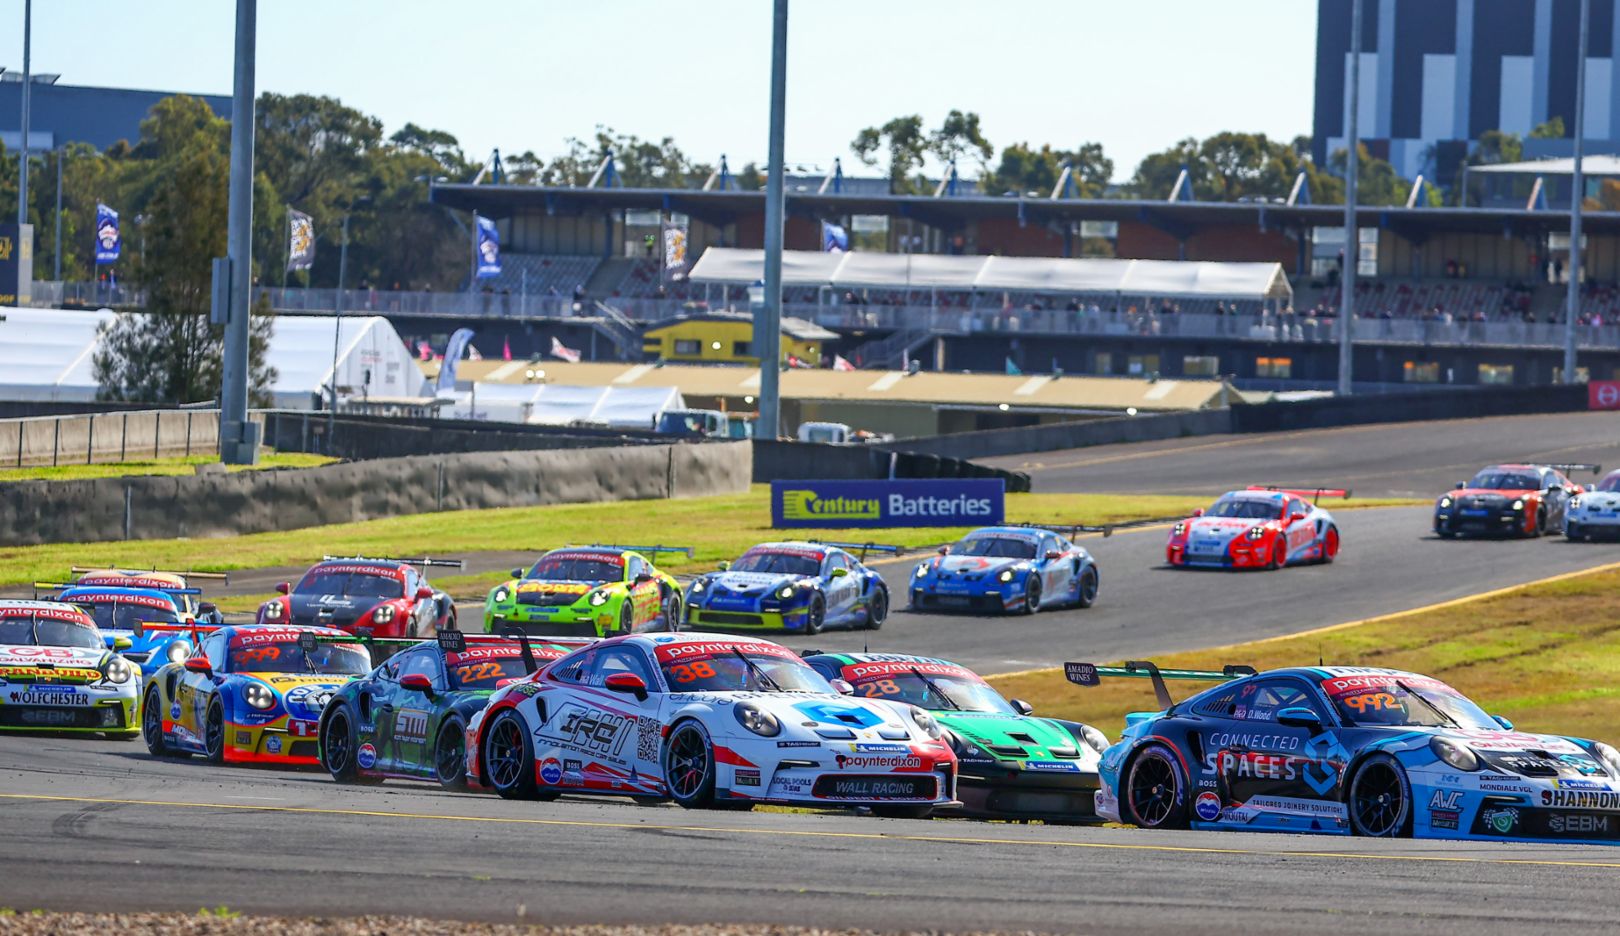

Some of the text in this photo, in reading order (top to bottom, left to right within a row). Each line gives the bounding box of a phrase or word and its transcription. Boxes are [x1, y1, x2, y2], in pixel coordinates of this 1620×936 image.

[783, 490, 991, 519] Century Batteries
[67, 594, 166, 607] paynterdixon
[0, 606, 84, 622] ynterdixon
[241, 632, 300, 645] paynte
[457, 646, 565, 661] payntedixo
[456, 662, 507, 684] 222
[670, 660, 718, 684] 38
[1067, 664, 1094, 676] AMADIO
[1069, 674, 1092, 683] WINES
[858, 679, 901, 698] 28
[10, 691, 89, 705] WOLFCHESTER
[1344, 692, 1402, 714] 992
[1209, 732, 1299, 750] CONNECTED
[845, 756, 921, 769] paynterdixon
[1202, 752, 1297, 781] SPACES
[793, 778, 812, 786] POOLS
[836, 781, 914, 794] WALL RACING
[1198, 779, 1217, 788] BOSS
[1480, 783, 1517, 792] MONDIALE
[1252, 799, 1343, 814] TAILORED JOINERY SOLUTIONS
